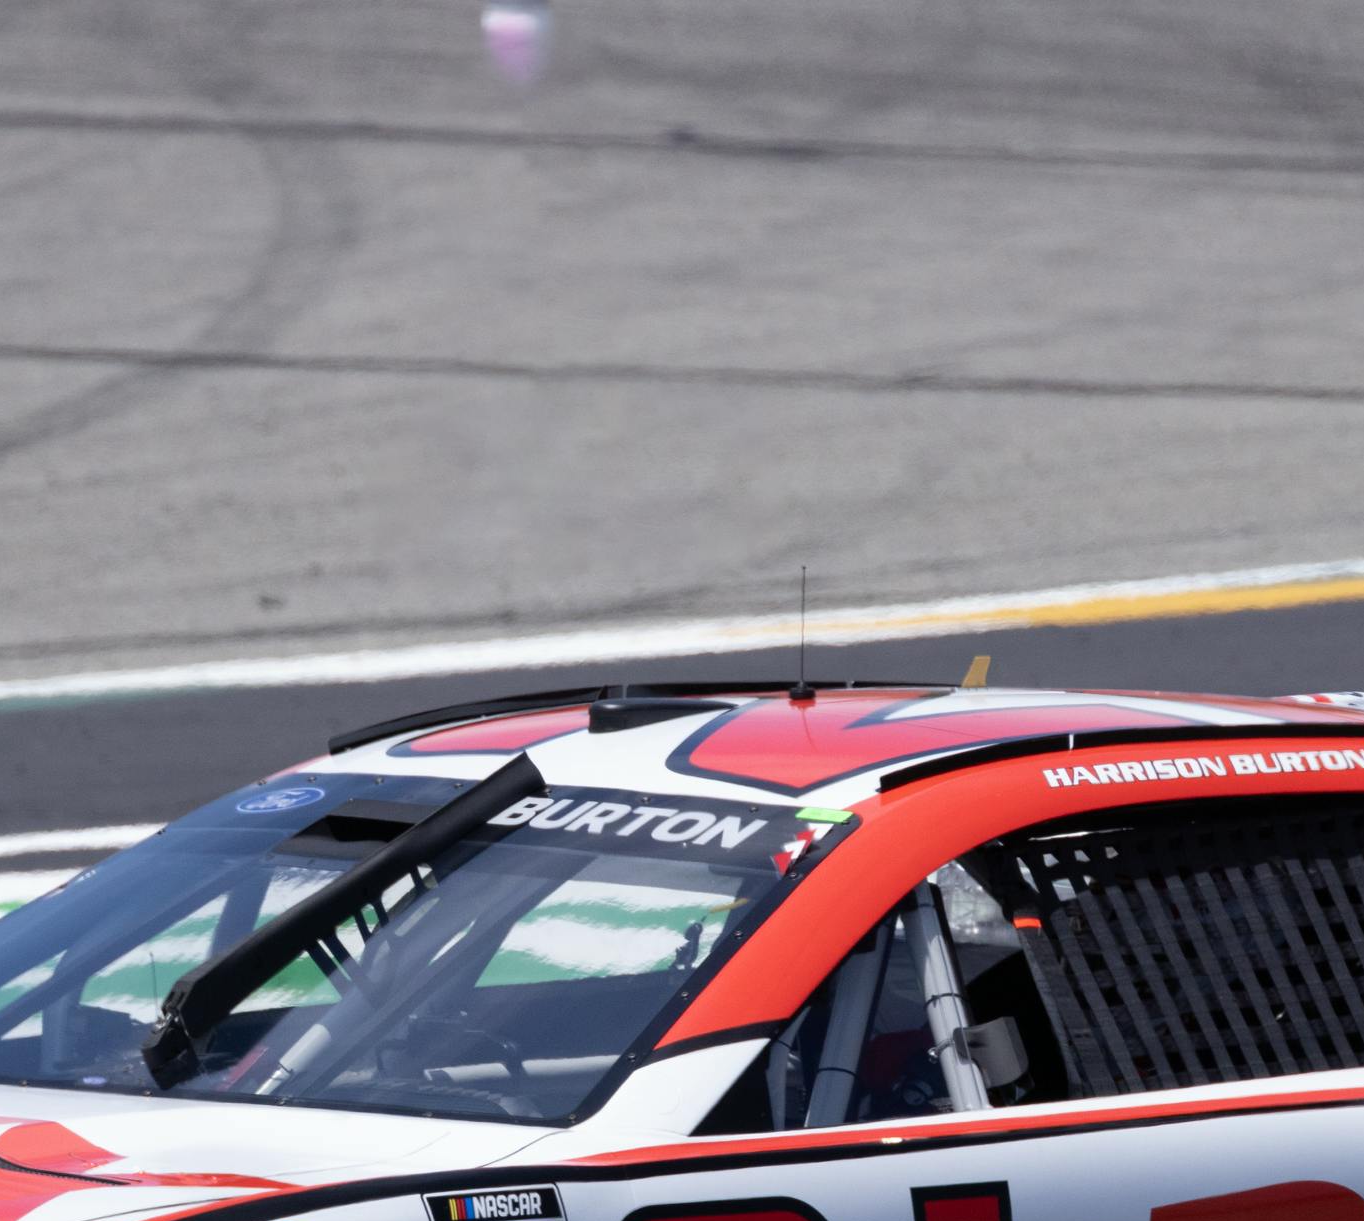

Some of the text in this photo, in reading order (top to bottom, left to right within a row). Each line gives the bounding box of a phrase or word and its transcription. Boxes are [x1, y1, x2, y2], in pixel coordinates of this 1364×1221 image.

[1043, 756, 1227, 788] HARRISON
[487, 796, 768, 849] BURTON
[473, 1192, 542, 1220] NASCAR
